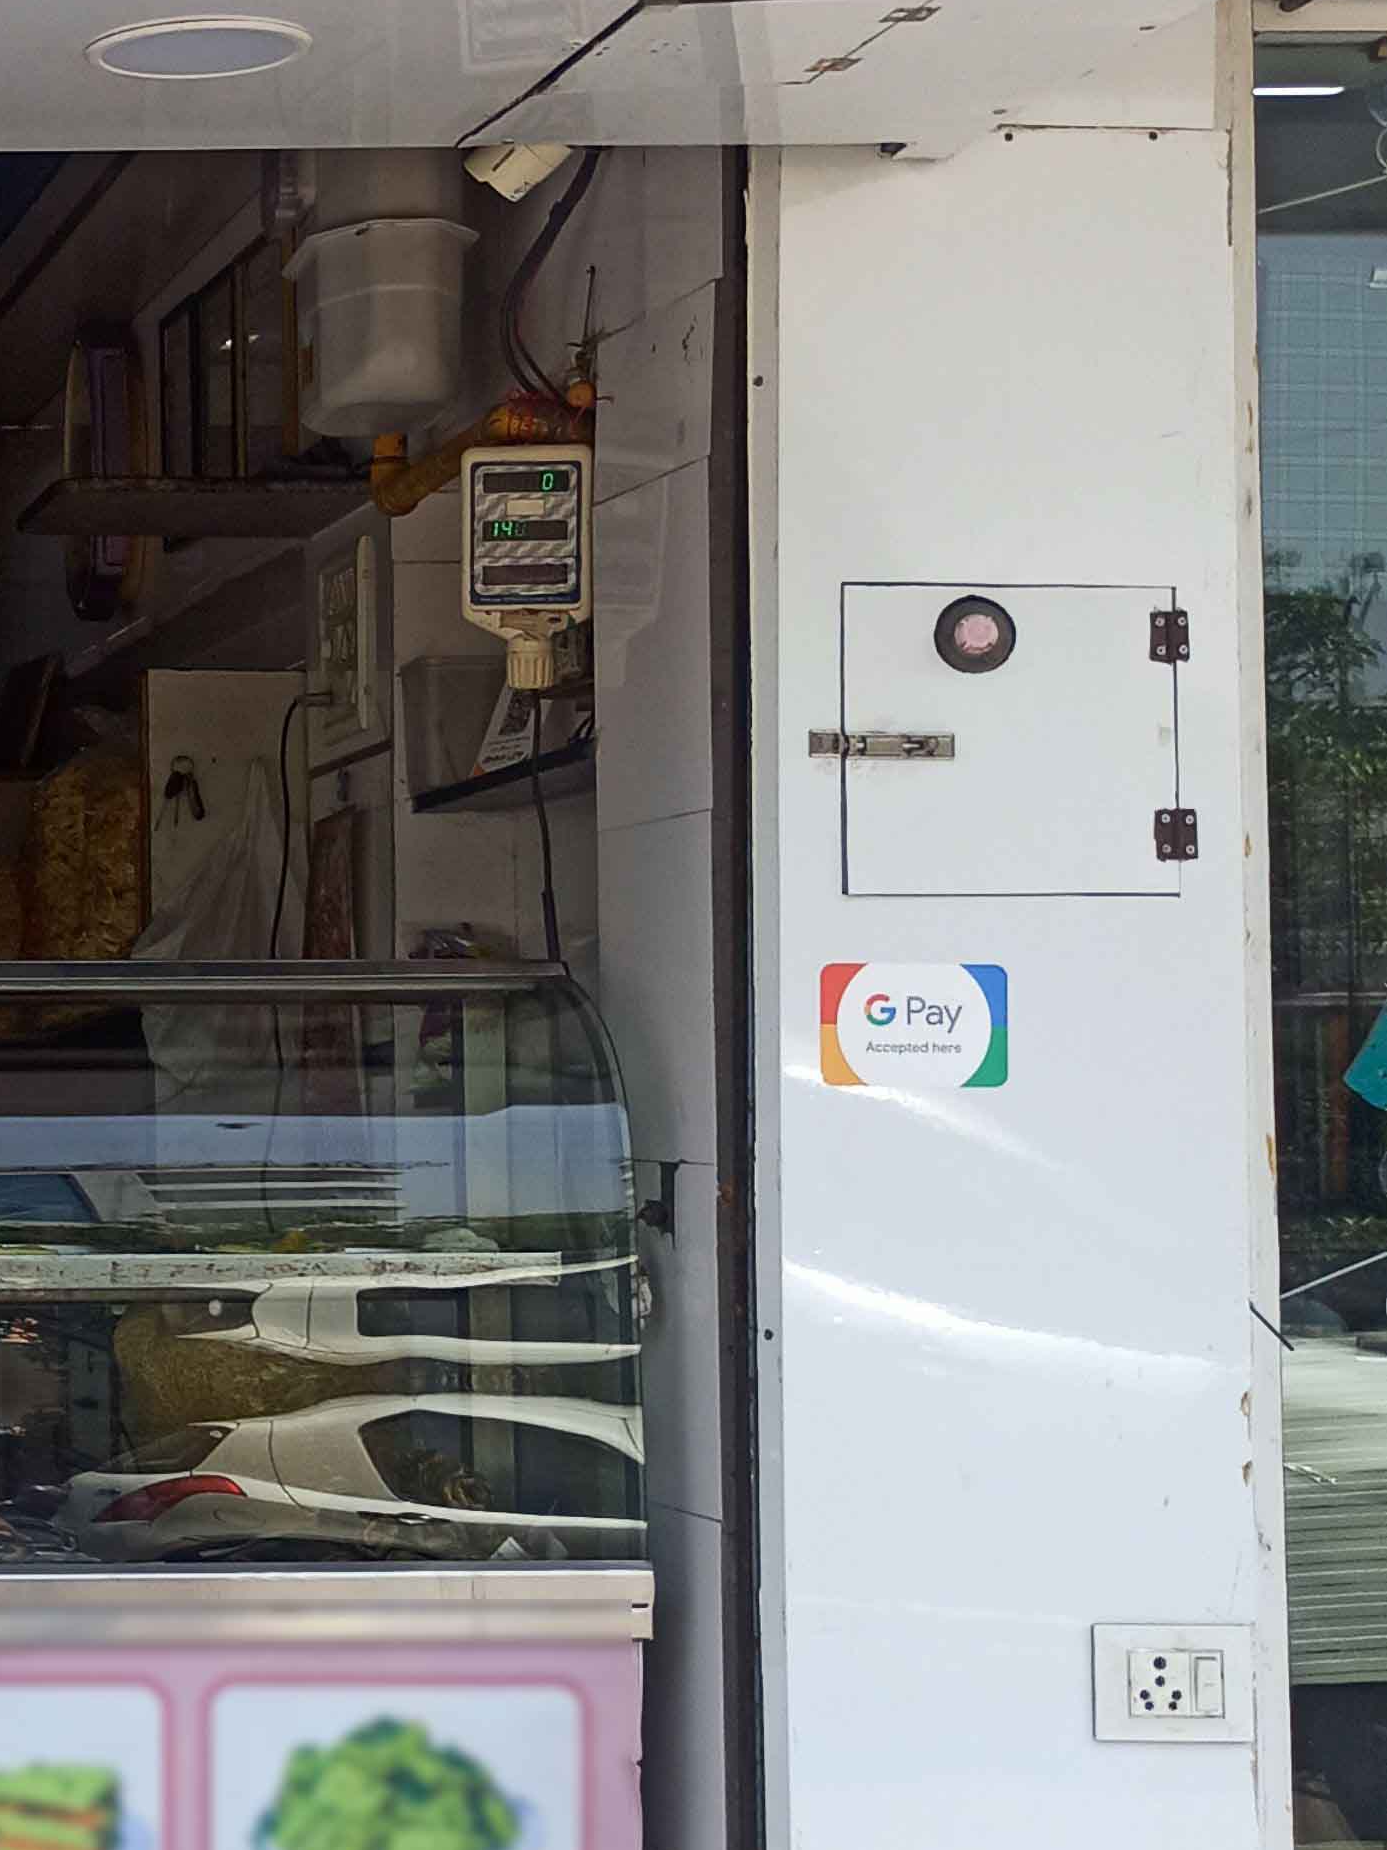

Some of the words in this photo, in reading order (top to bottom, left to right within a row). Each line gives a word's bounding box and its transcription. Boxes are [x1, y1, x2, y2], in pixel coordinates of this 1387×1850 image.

[864, 994, 897, 1026] G
[906, 996, 963, 1034] Pay
[865, 1041, 929, 1055] Accepted
[932, 1042, 962, 1053] here
